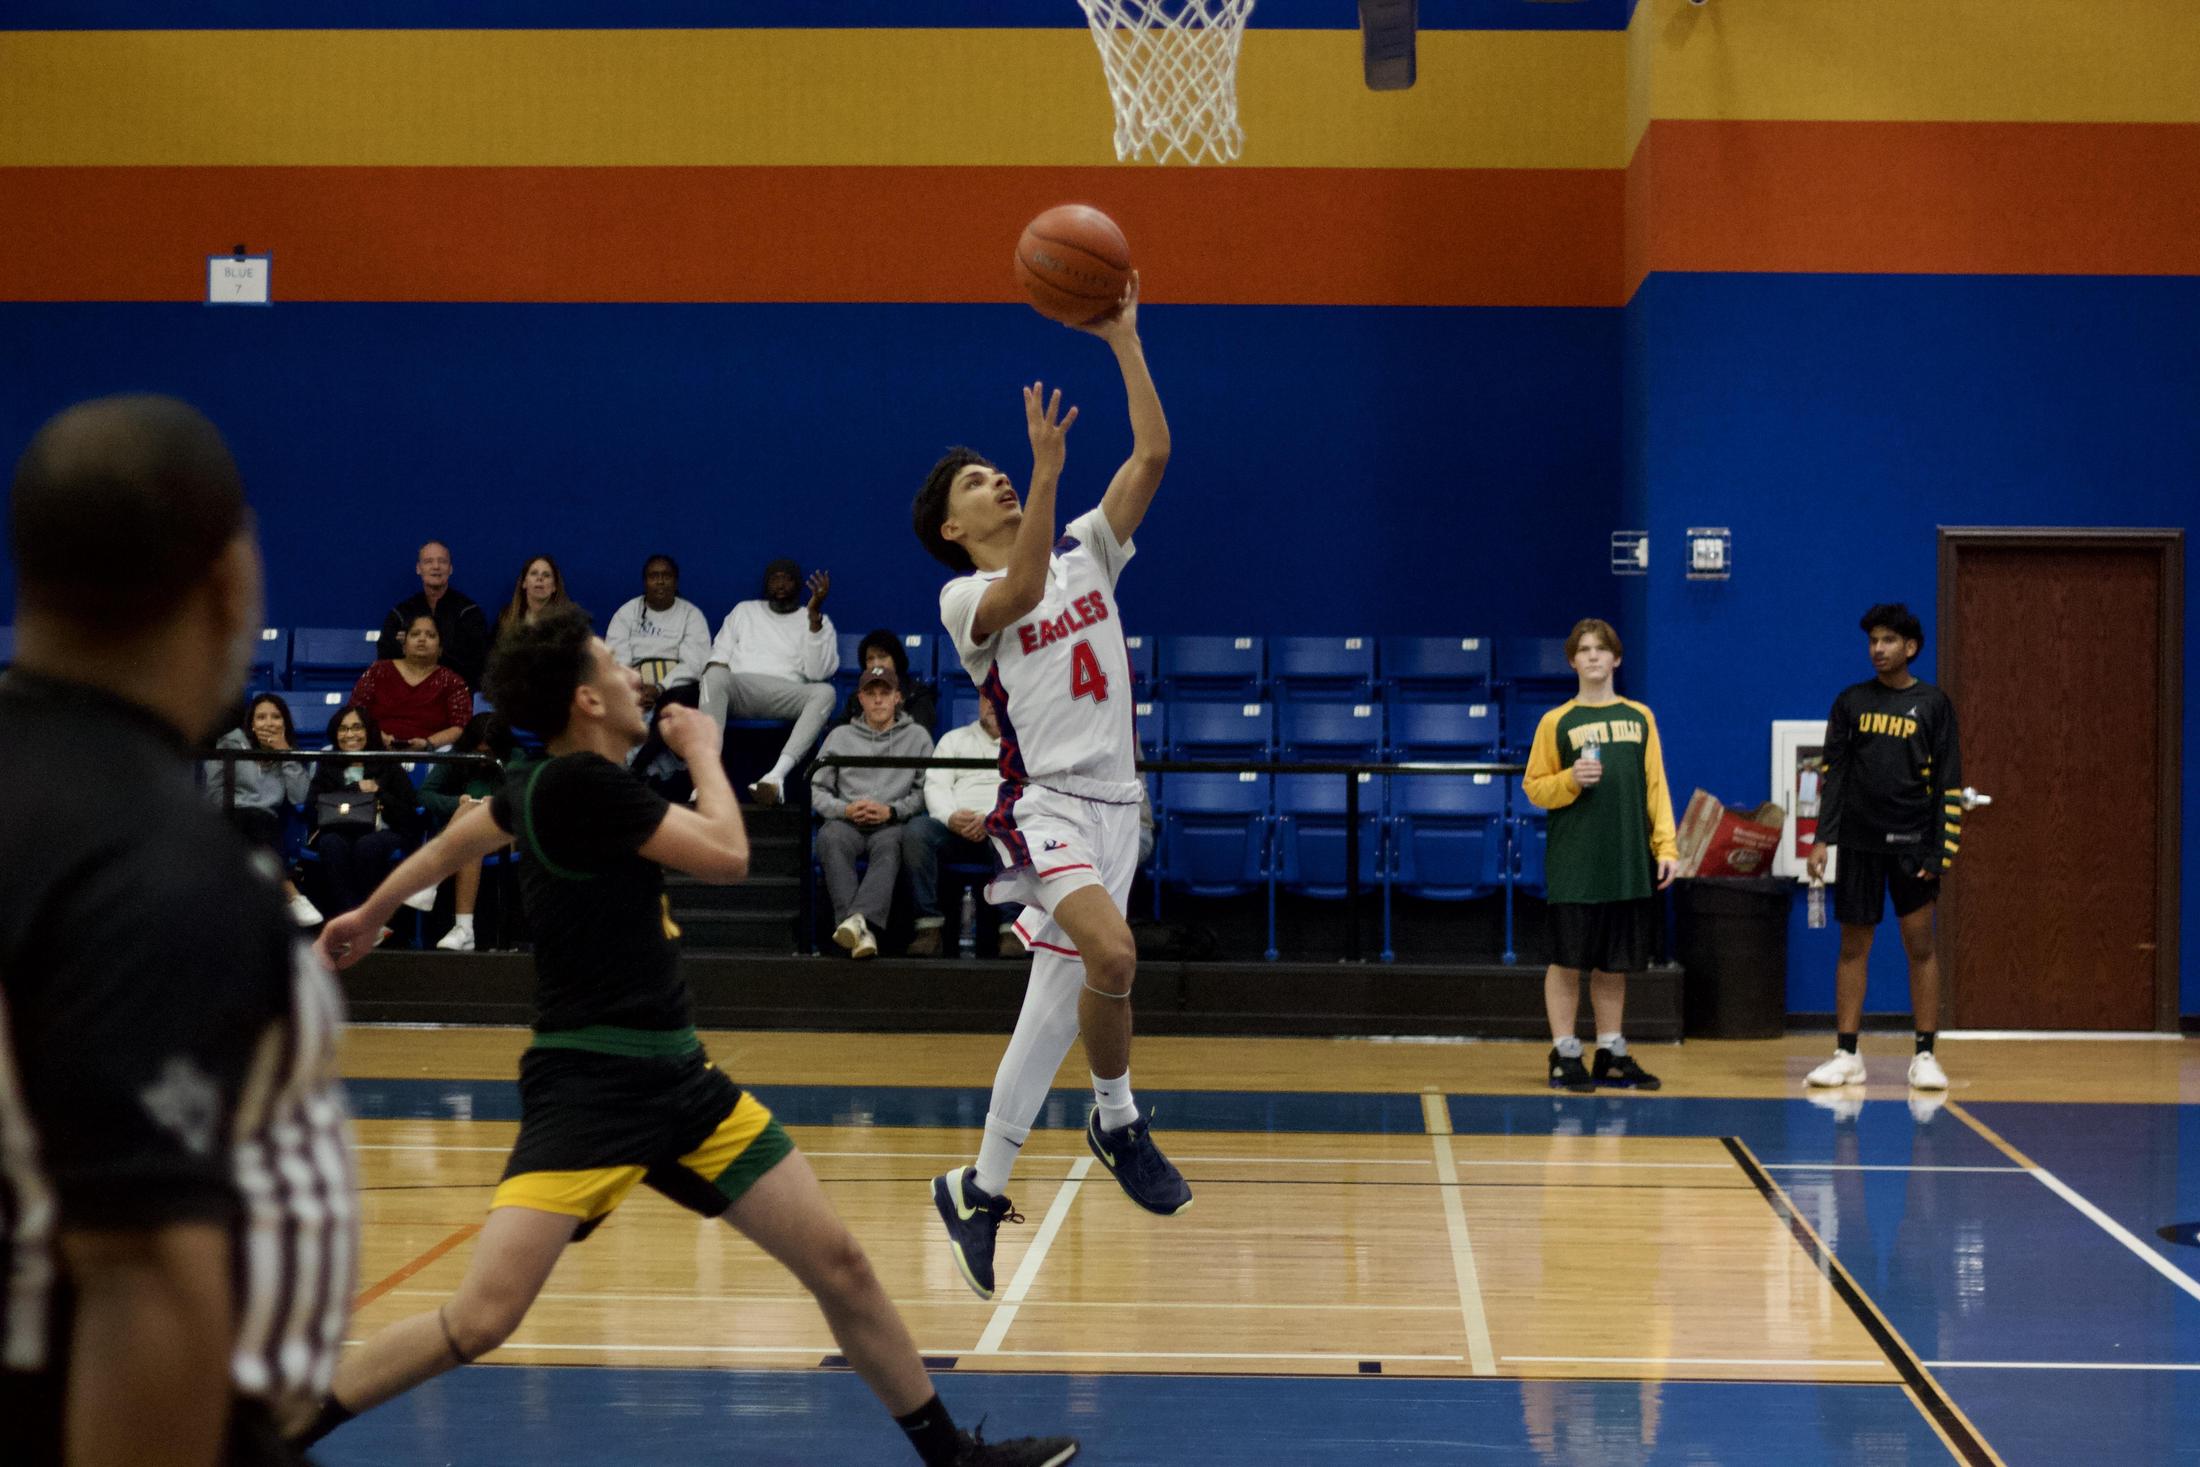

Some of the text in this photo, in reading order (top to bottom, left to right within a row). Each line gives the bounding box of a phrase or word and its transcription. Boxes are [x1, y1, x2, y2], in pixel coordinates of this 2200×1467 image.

[224, 266, 254, 279] BLUE
[234, 283, 243, 296] 7
[1070, 638, 1109, 704] 4
[1858, 712, 1918, 739] UNHP
